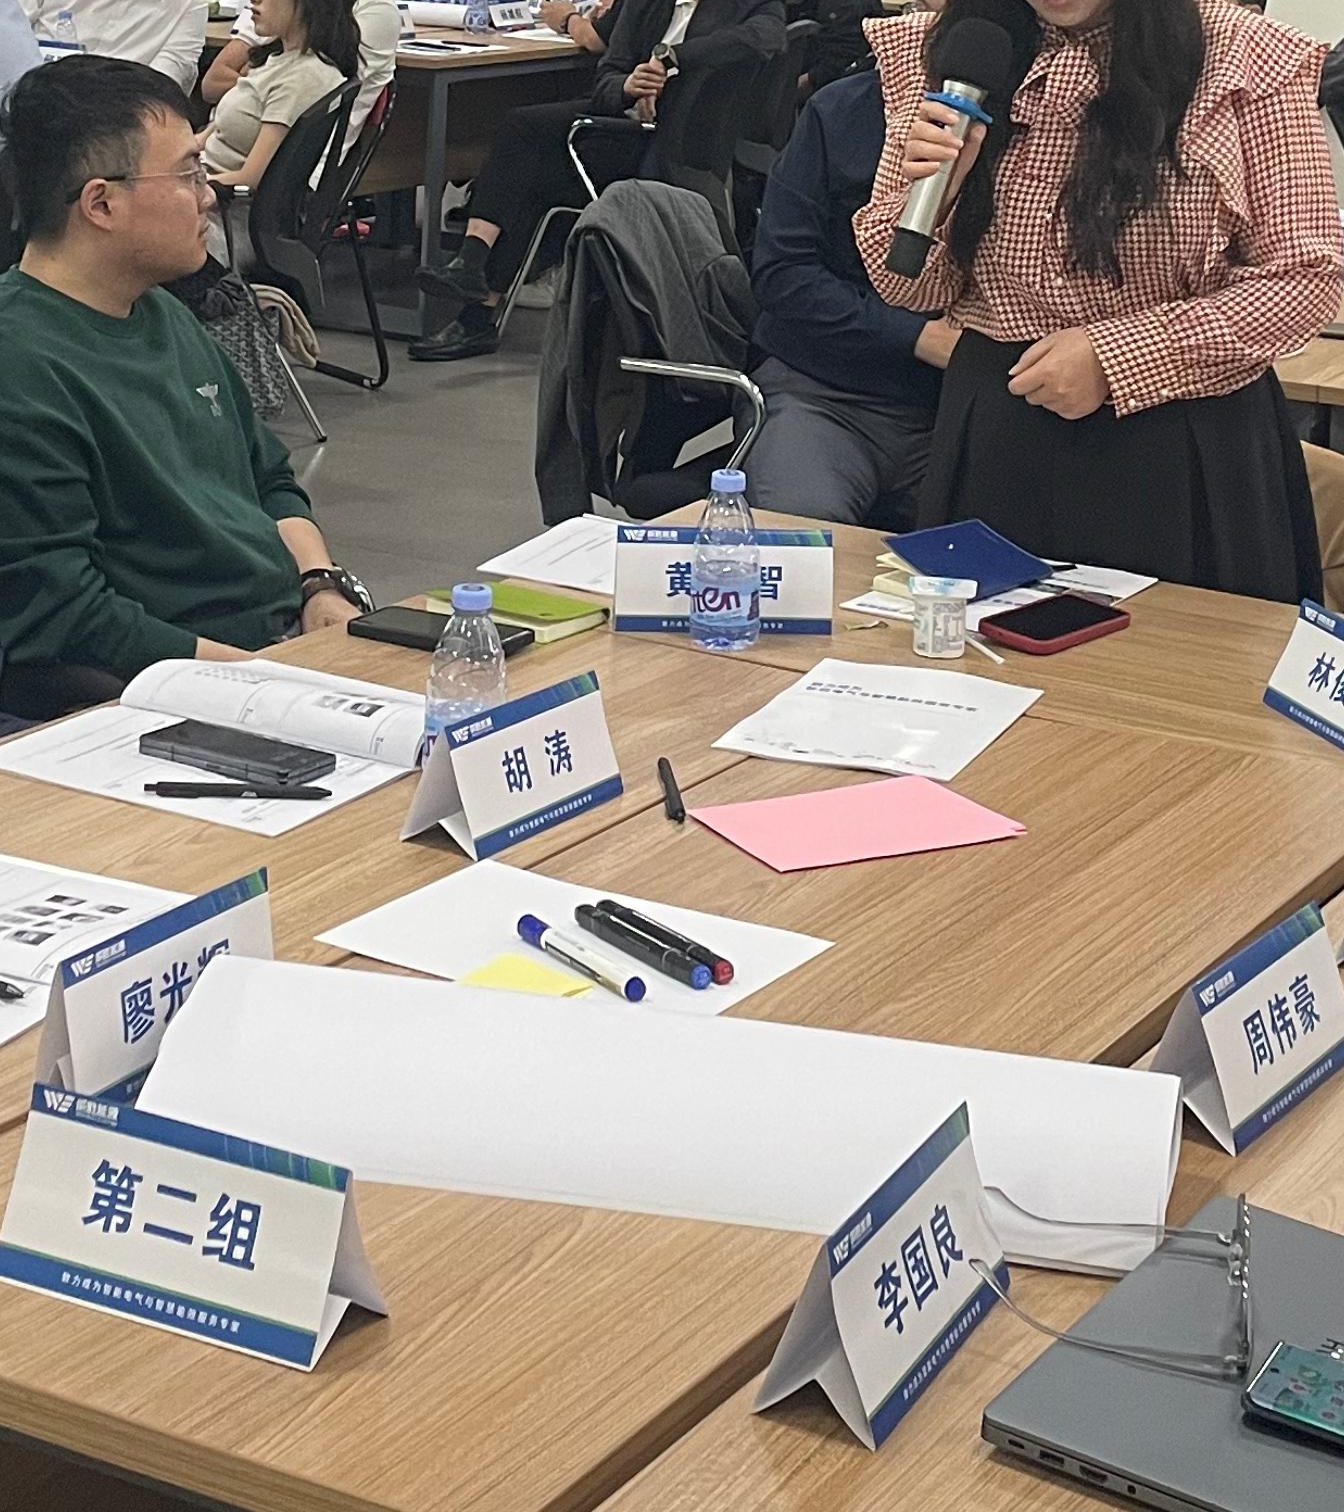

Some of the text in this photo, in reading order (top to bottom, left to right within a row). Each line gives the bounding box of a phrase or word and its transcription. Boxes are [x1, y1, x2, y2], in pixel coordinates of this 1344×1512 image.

[665, 561, 783, 600] 黄智
[501, 729, 574, 794] 胡涛
[1242, 973, 1321, 1075] 周伟豪
[82, 1158, 263, 1272] 第二组
[873, 1203, 964, 1335] 李国良
